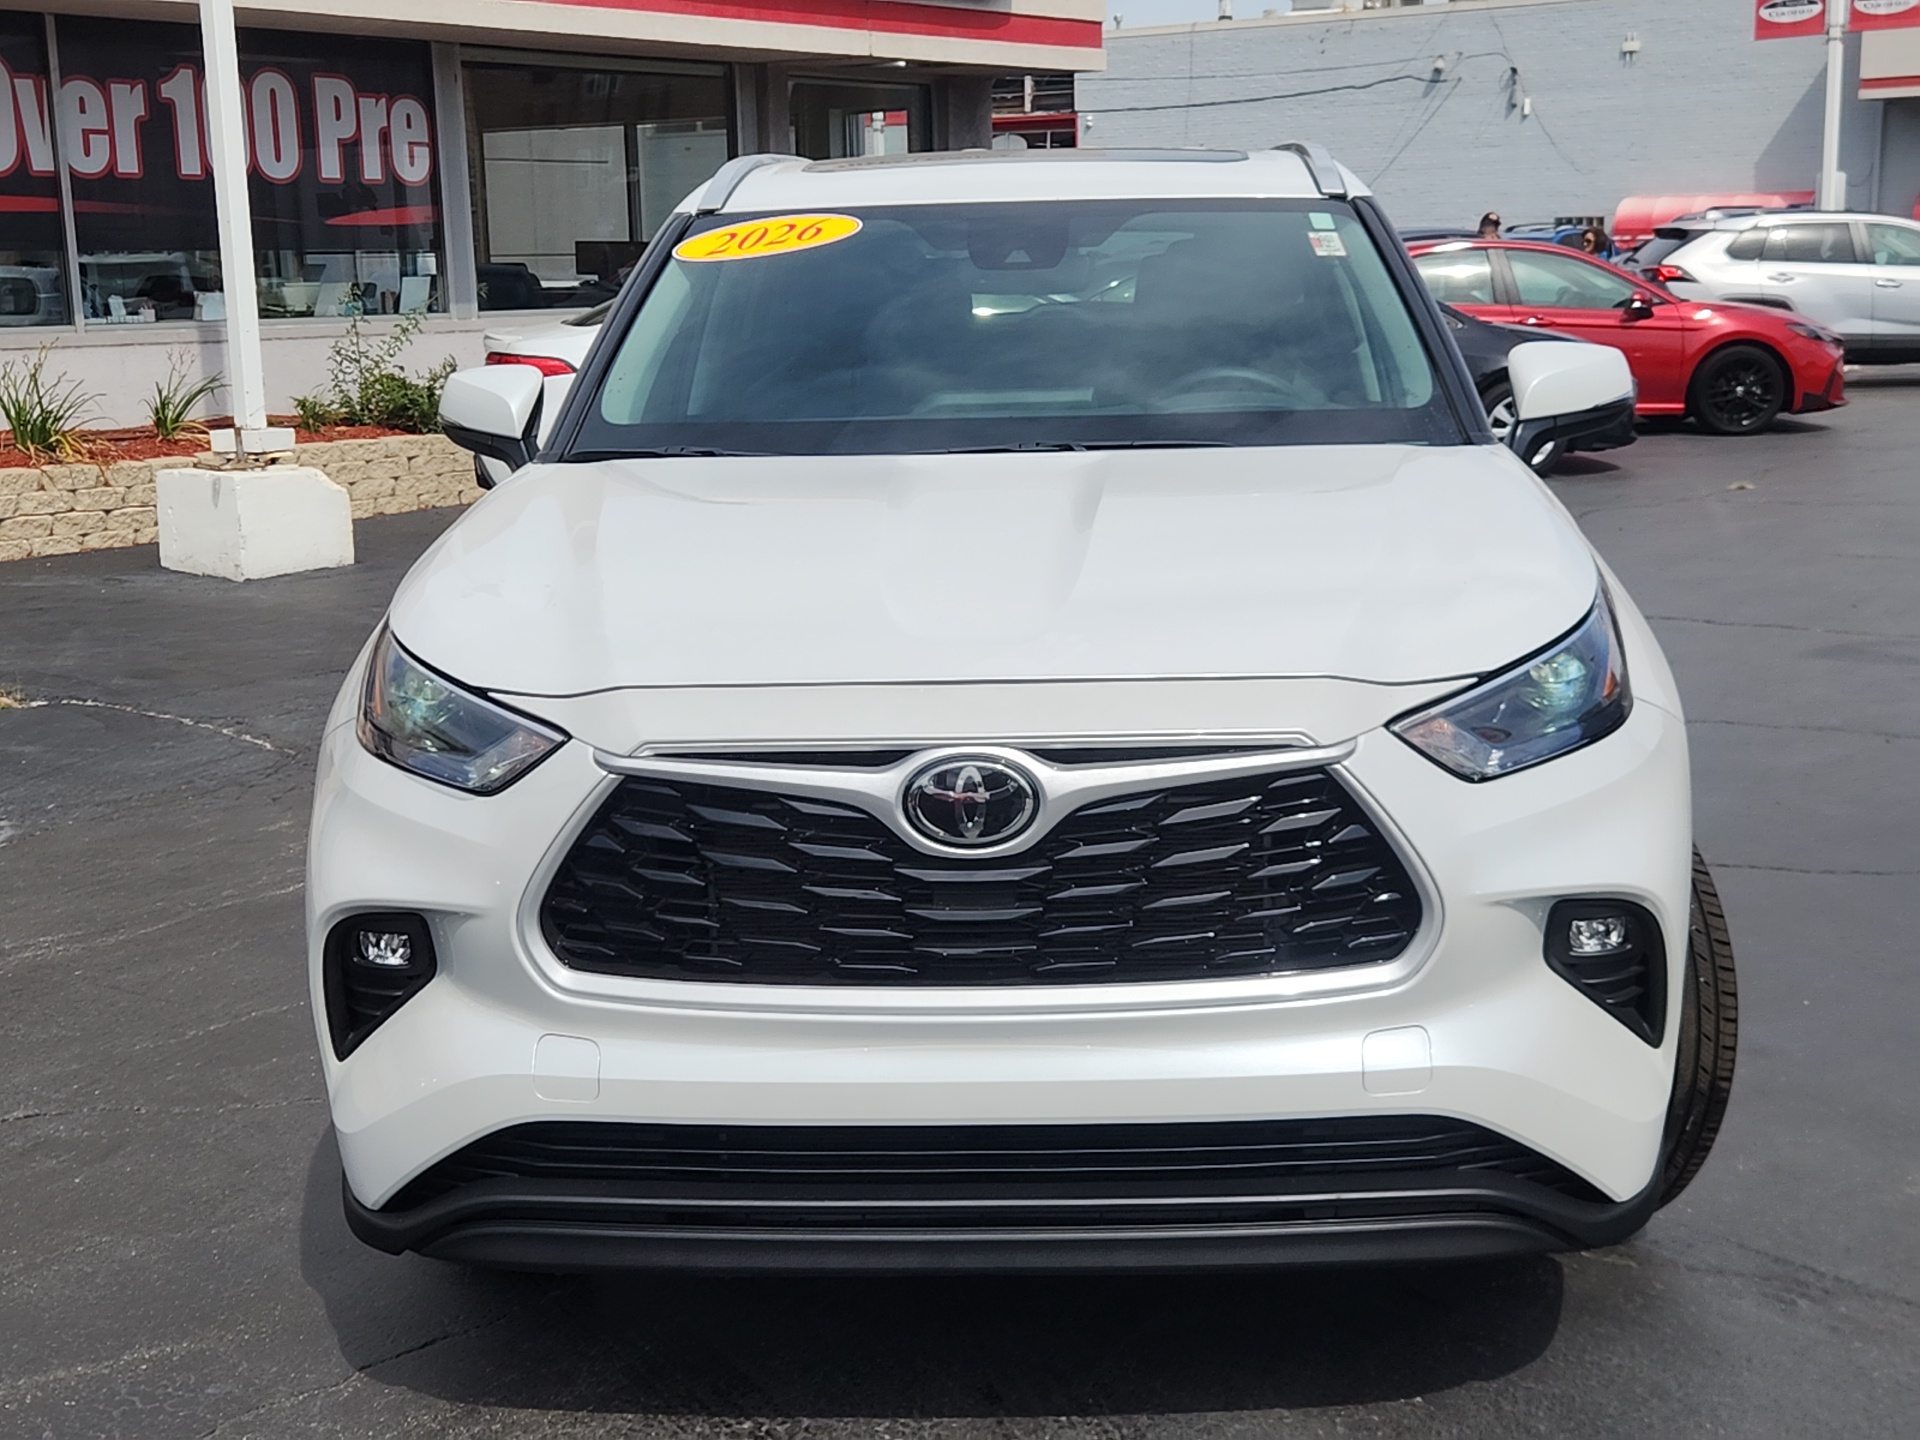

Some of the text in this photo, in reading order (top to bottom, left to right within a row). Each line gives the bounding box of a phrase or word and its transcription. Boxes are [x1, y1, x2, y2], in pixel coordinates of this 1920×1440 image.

[157, 63, 304, 185] 10
[310, 72, 434, 187] Pre
[704, 217, 832, 257] 2026
